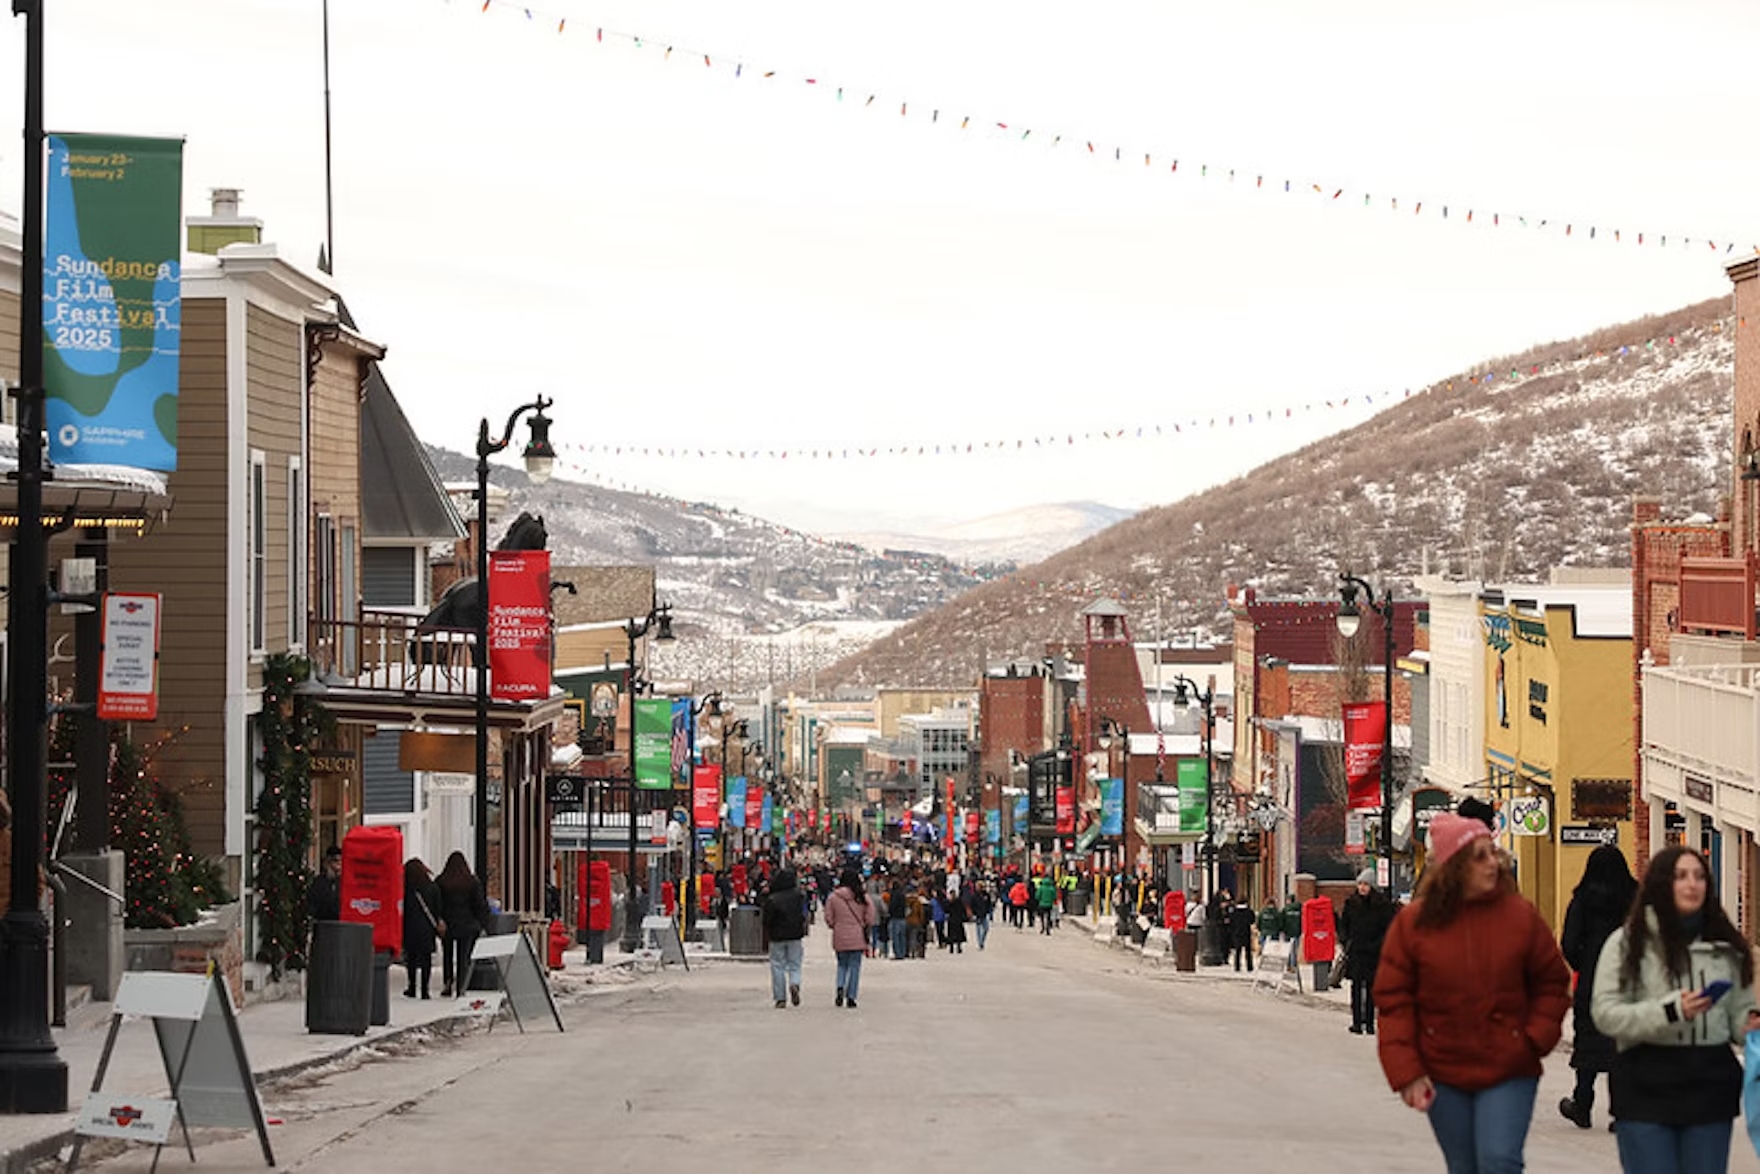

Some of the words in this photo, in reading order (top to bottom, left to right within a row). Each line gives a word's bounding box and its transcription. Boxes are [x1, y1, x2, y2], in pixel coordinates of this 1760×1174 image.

[61, 166, 114, 181] February
[57, 254, 171, 278] Sundance
[57, 279, 114, 299] Film
[57, 303, 168, 325] Festival
[57, 327, 112, 346] 2025
[494, 604, 545, 616] Sundance
[494, 616, 521, 626] Film
[494, 627, 545, 639] Festival
[502, 683, 538, 692] ACURA
[309, 757, 356, 771] RSUCH
